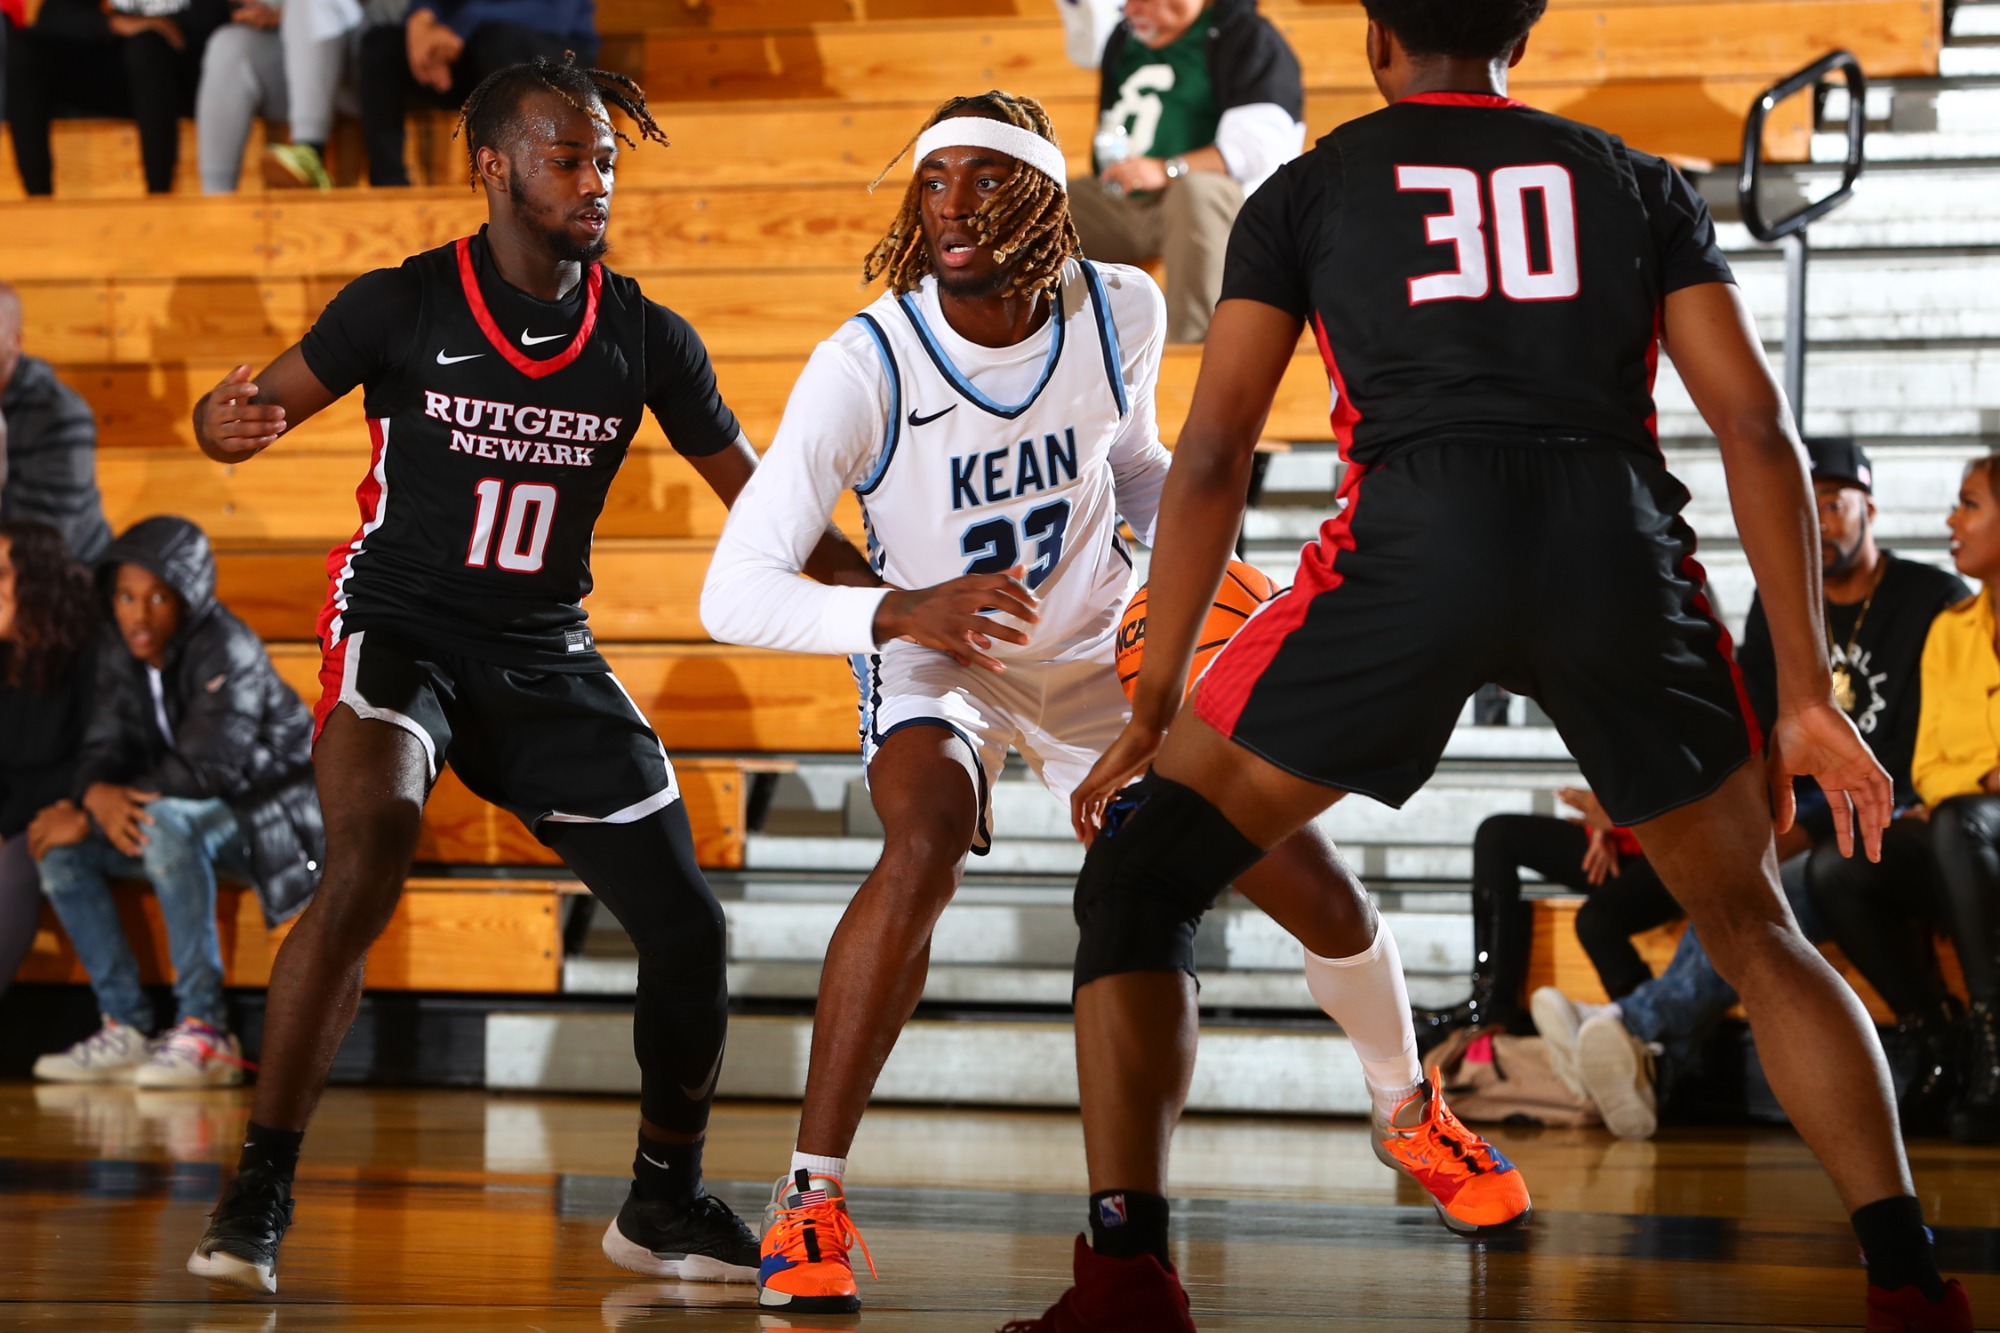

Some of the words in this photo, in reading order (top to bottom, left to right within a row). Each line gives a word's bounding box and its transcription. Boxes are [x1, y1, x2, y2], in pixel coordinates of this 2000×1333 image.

[1393, 162, 1581, 307] 30
[424, 390, 623, 443] RUTGERS
[449, 429, 595, 467] NEWARK
[950, 425, 1078, 511] KEAN
[464, 476, 560, 574] 10
[959, 497, 1072, 608] 23
